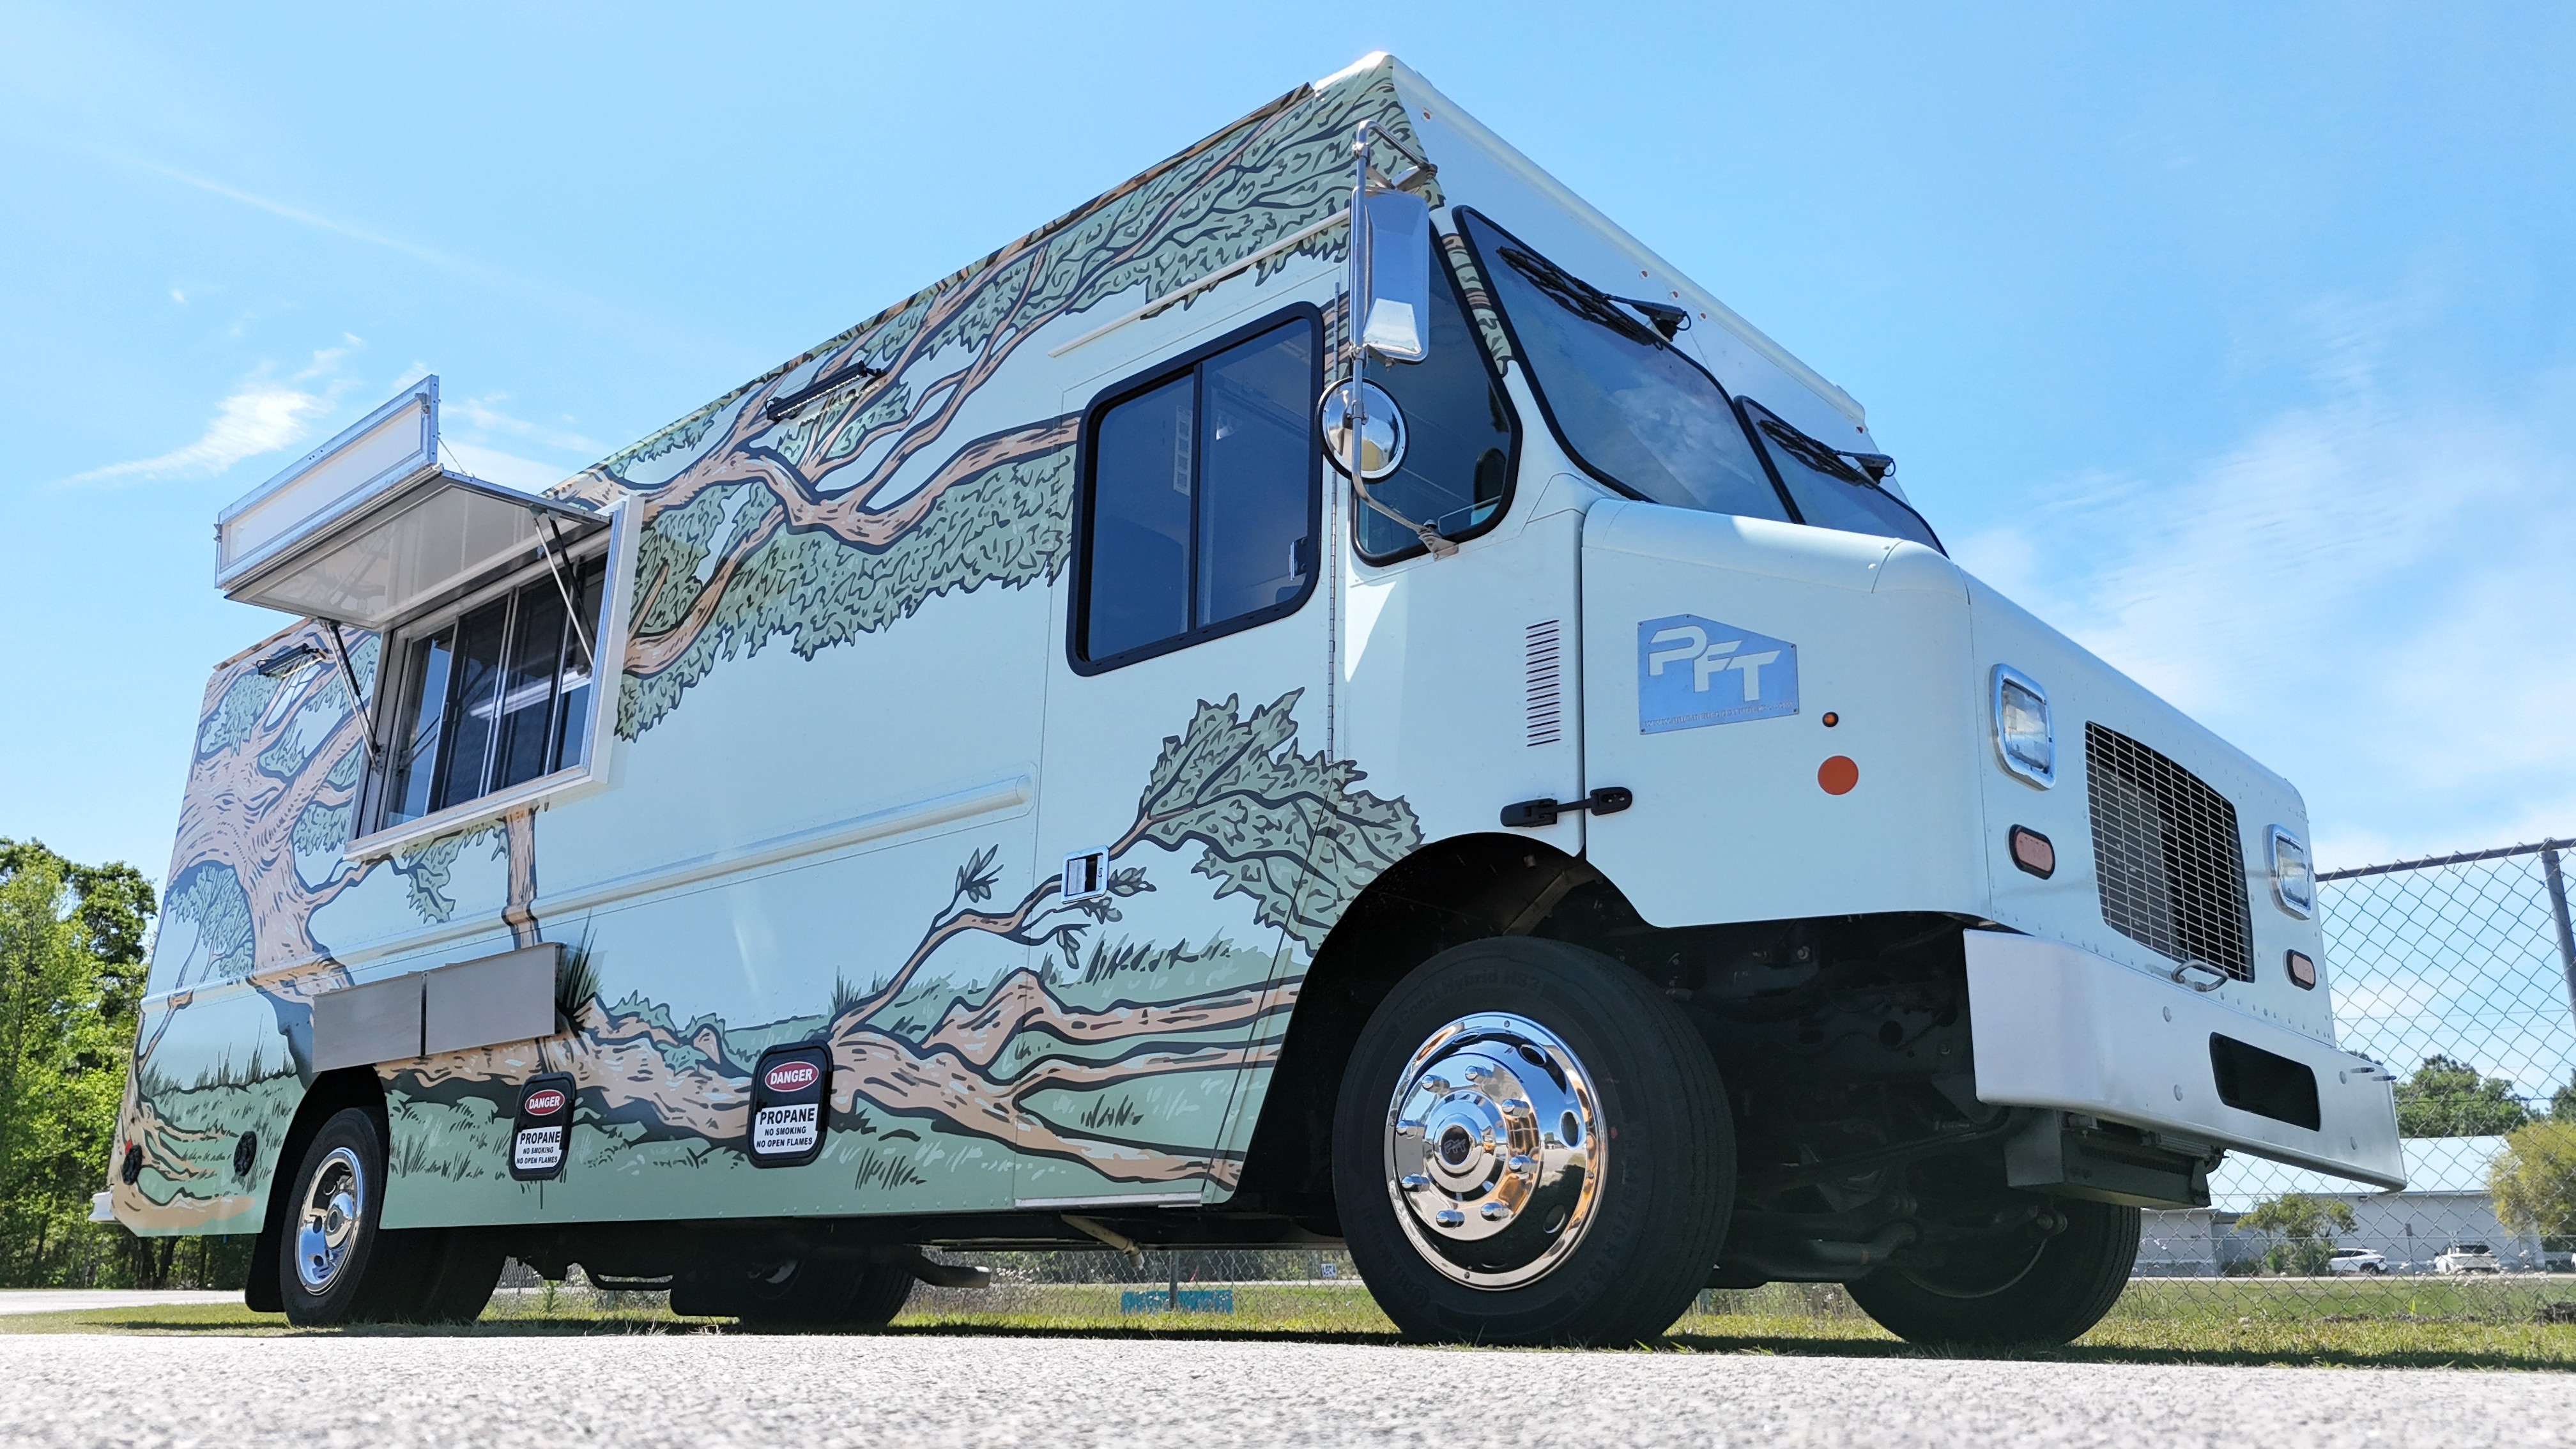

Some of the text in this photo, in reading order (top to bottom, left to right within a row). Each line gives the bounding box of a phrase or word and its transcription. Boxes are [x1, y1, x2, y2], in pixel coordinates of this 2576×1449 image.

[1648, 624, 1781, 702] PFT
[770, 1068, 813, 1085] DANGER
[528, 1096, 560, 1110] DANGER
[760, 1108, 815, 1125] PROPANE
[776, 1126, 806, 1135] SMOKING
[519, 1131, 560, 1145] PROPANE
[756, 1137, 813, 1148] NO OPEN FLAMES
